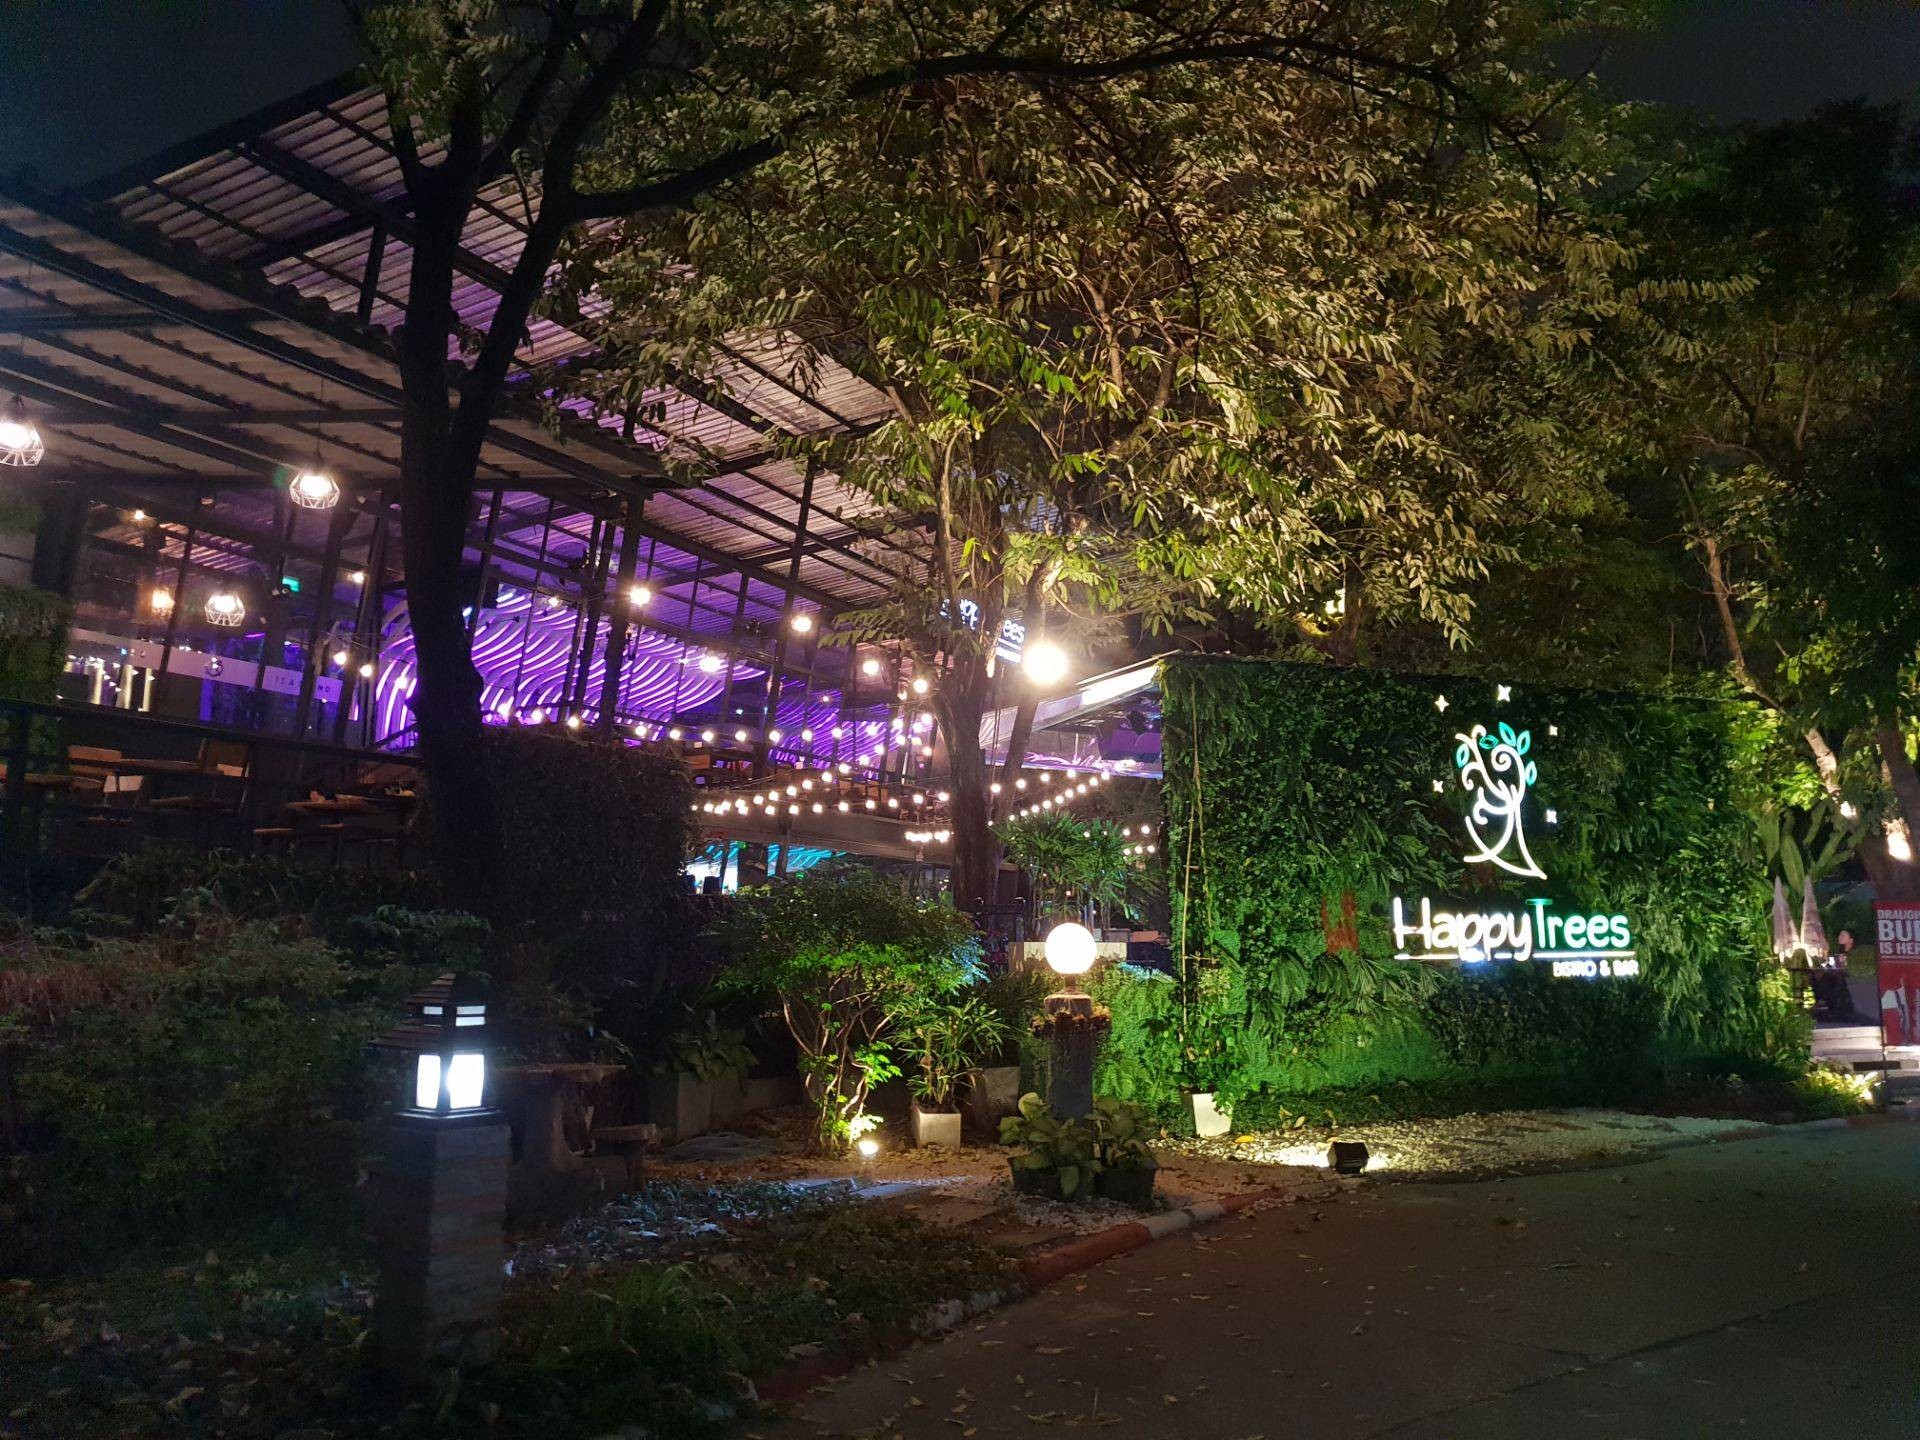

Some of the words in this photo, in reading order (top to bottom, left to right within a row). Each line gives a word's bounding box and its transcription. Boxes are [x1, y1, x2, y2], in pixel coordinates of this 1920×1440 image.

[1880, 942, 1894, 955] IS
[1600, 960, 1611, 976] &
[1612, 959, 1640, 976] BAR
